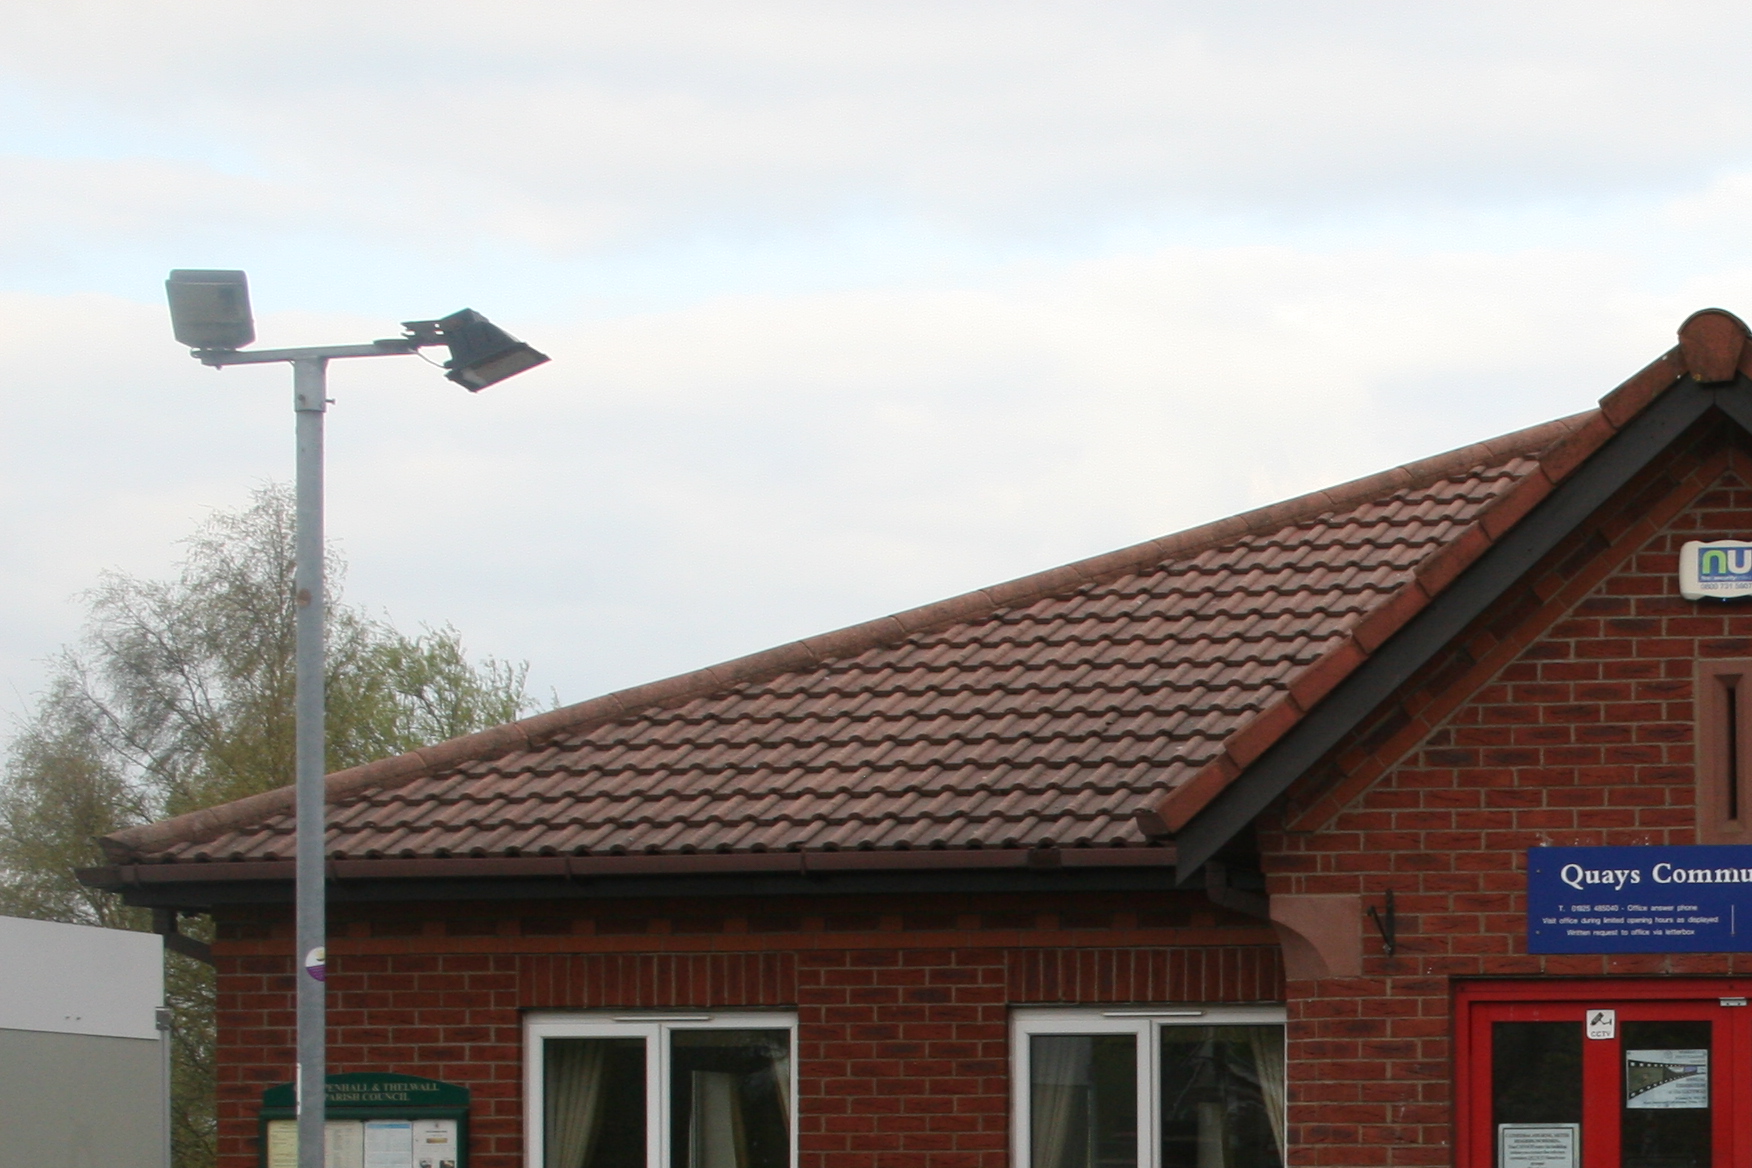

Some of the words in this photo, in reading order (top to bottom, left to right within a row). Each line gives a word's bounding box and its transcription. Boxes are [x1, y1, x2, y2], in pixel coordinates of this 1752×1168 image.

[1560, 863, 1640, 890] Quays
[372, 1083, 380, 1092] &
[384, 1082, 439, 1091] THELWALL
[362, 1092, 410, 1100] COUNCIL
